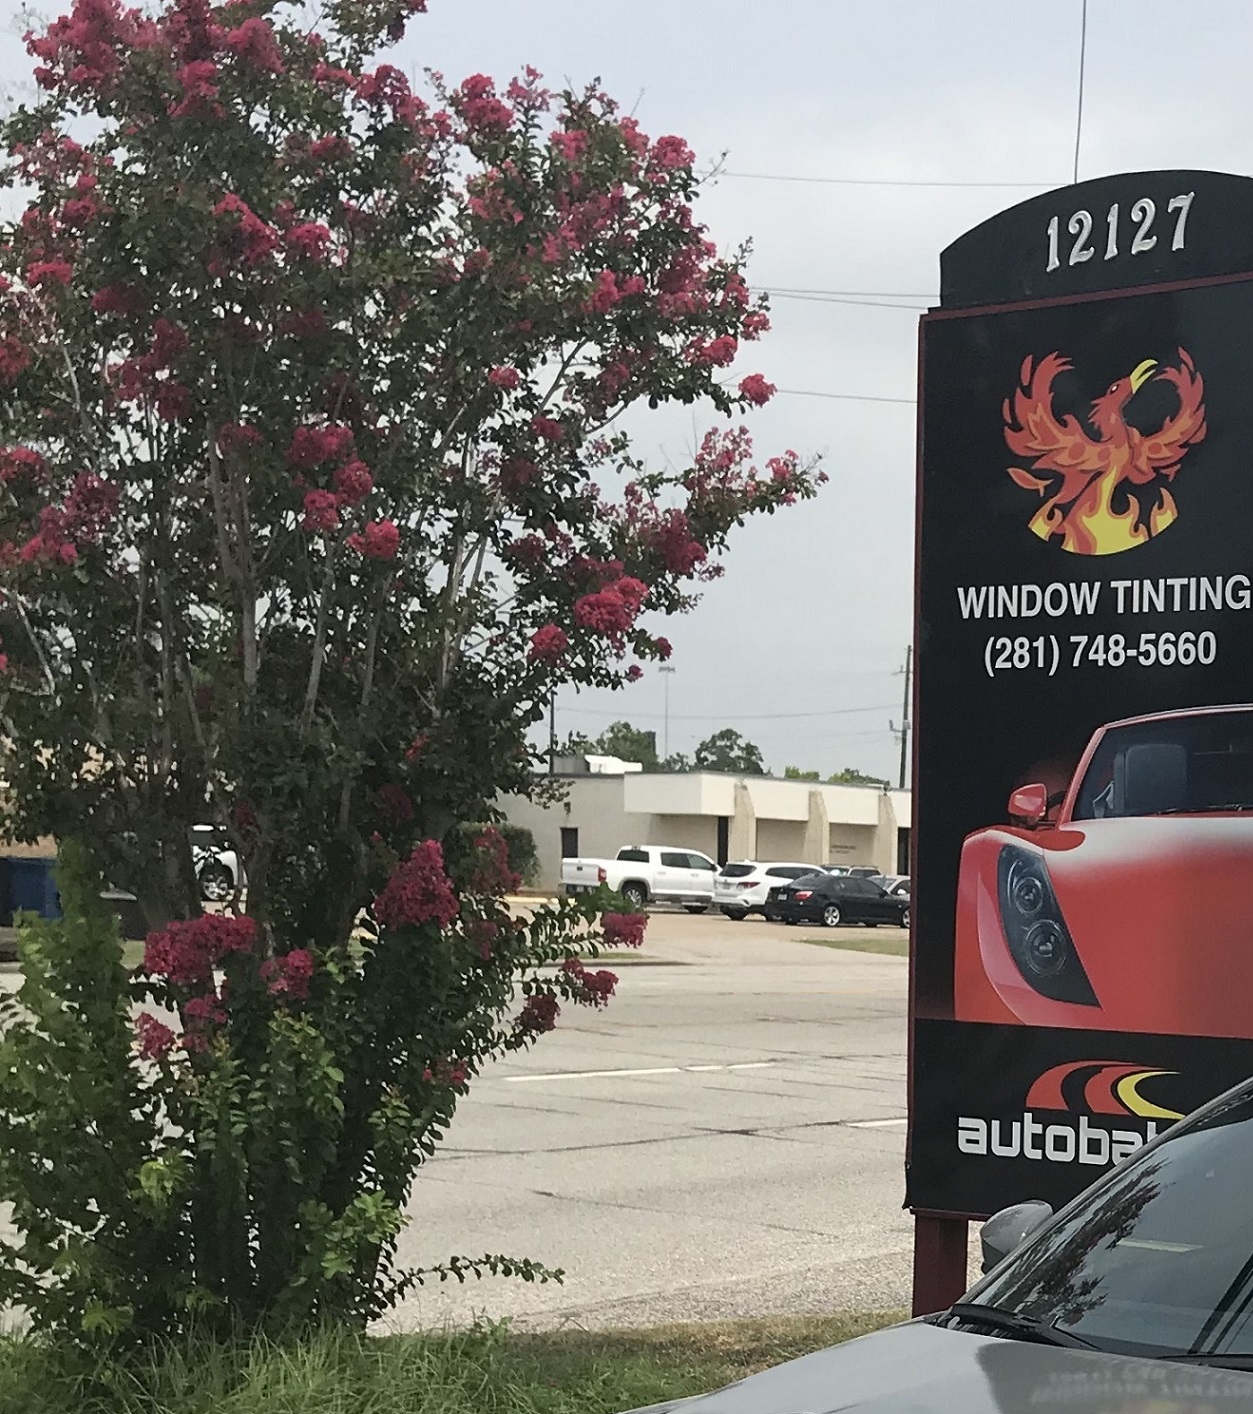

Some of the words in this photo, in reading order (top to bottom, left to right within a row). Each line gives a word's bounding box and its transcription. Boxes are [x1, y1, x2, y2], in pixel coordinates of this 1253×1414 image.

[1046, 191, 1195, 272] 12127
[957, 581, 1101, 619] WINDOW
[1110, 574, 1251, 614] TINTING
[984, 634, 1060, 678] (281)
[1069, 630, 1217, 667] 748-5660
